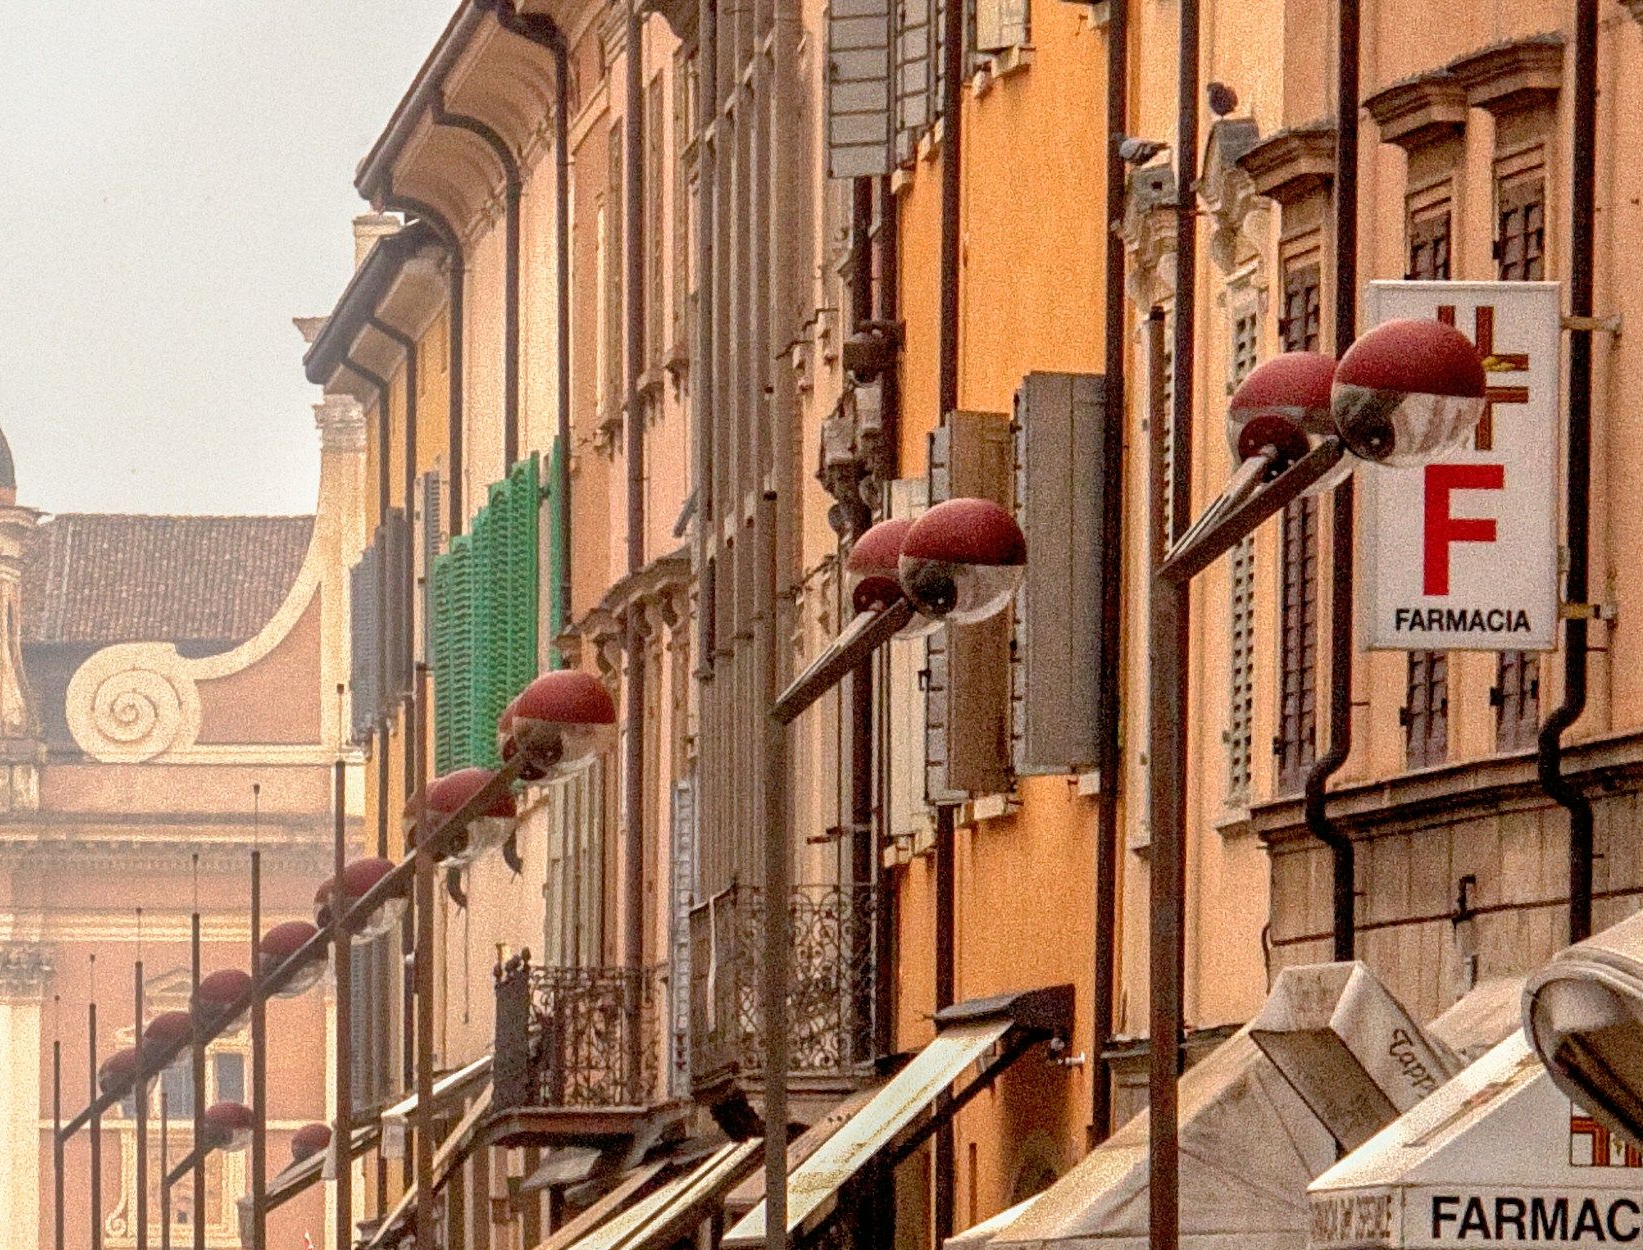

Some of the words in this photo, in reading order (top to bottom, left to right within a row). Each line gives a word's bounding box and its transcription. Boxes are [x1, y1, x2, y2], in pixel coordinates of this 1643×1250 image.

[1424, 464, 1504, 596] F
[1395, 607, 1532, 632] FARMACIA
[1431, 1195, 1643, 1243] FARMAC
